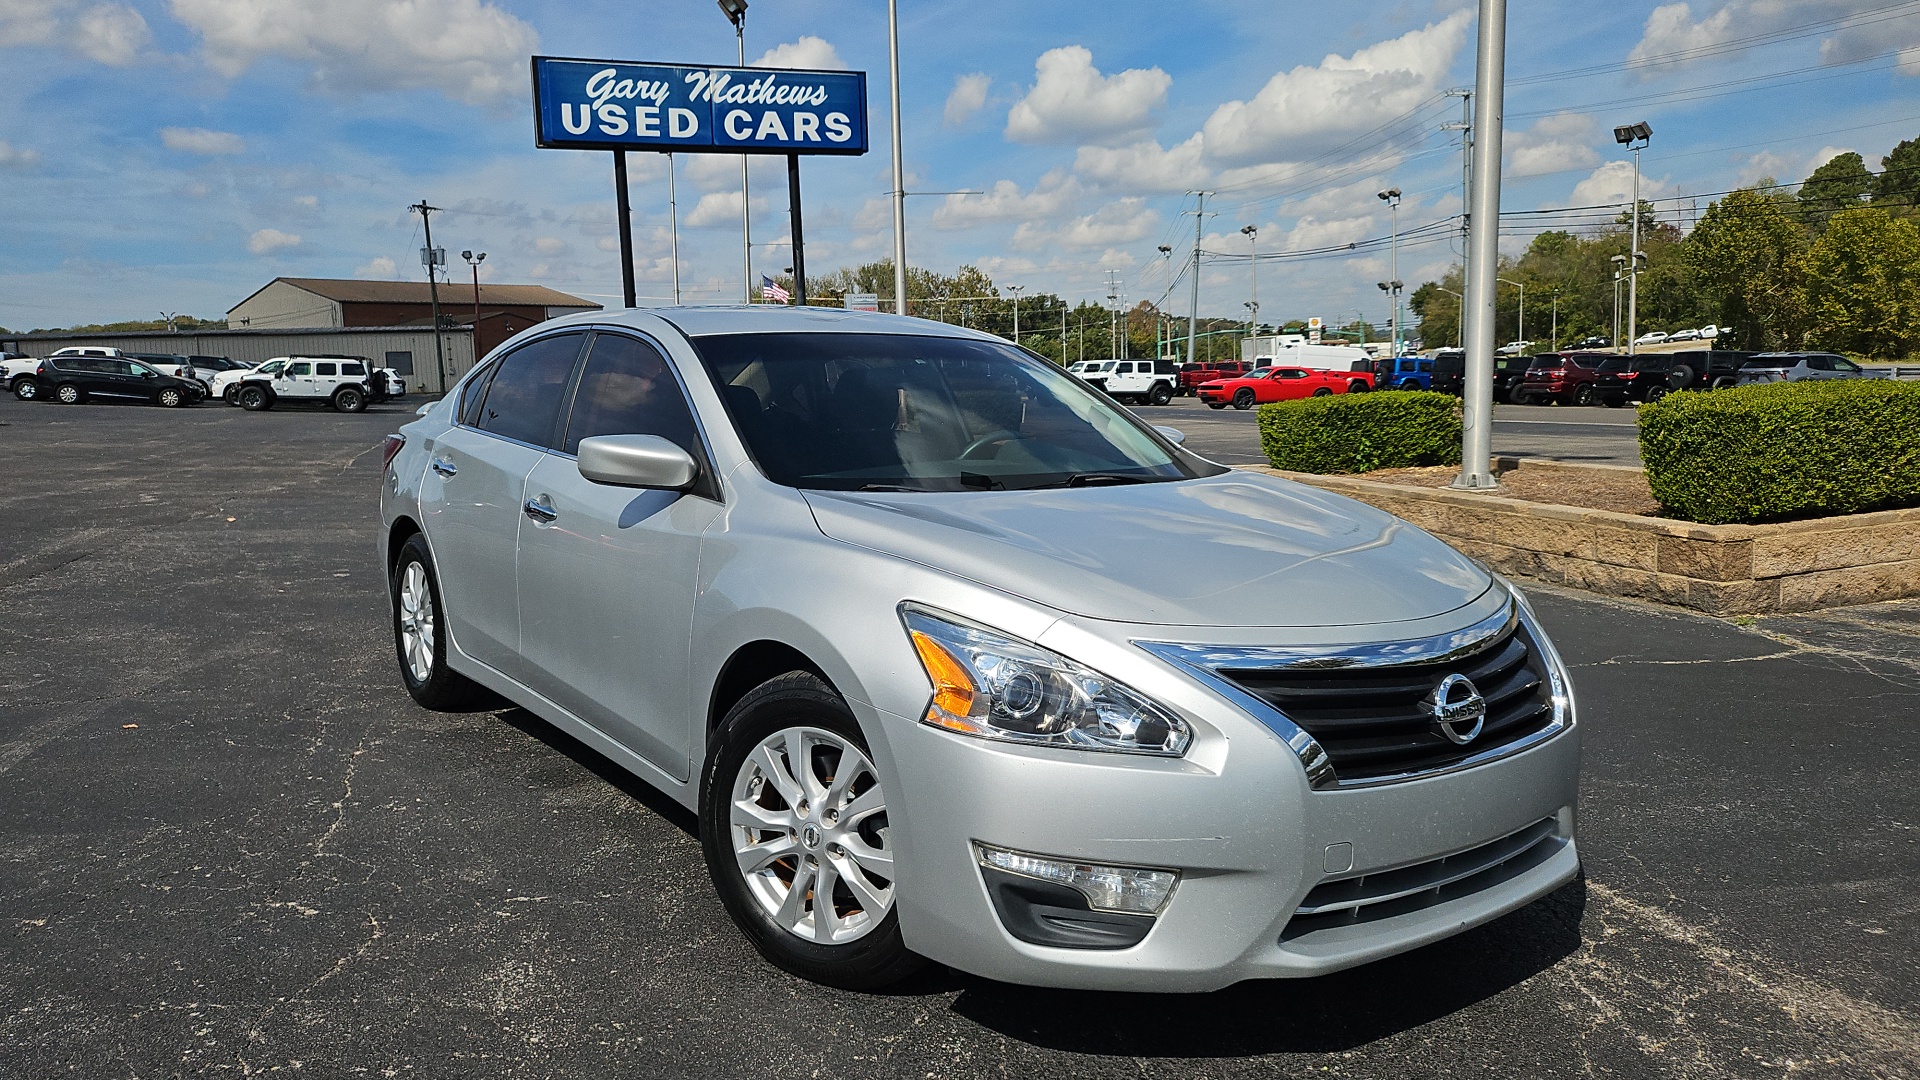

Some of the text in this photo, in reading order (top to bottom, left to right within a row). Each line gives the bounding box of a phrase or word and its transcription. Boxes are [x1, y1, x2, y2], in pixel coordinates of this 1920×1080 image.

[585, 68, 830, 110] Gary Mathews
[561, 103, 852, 142] USED CARS
